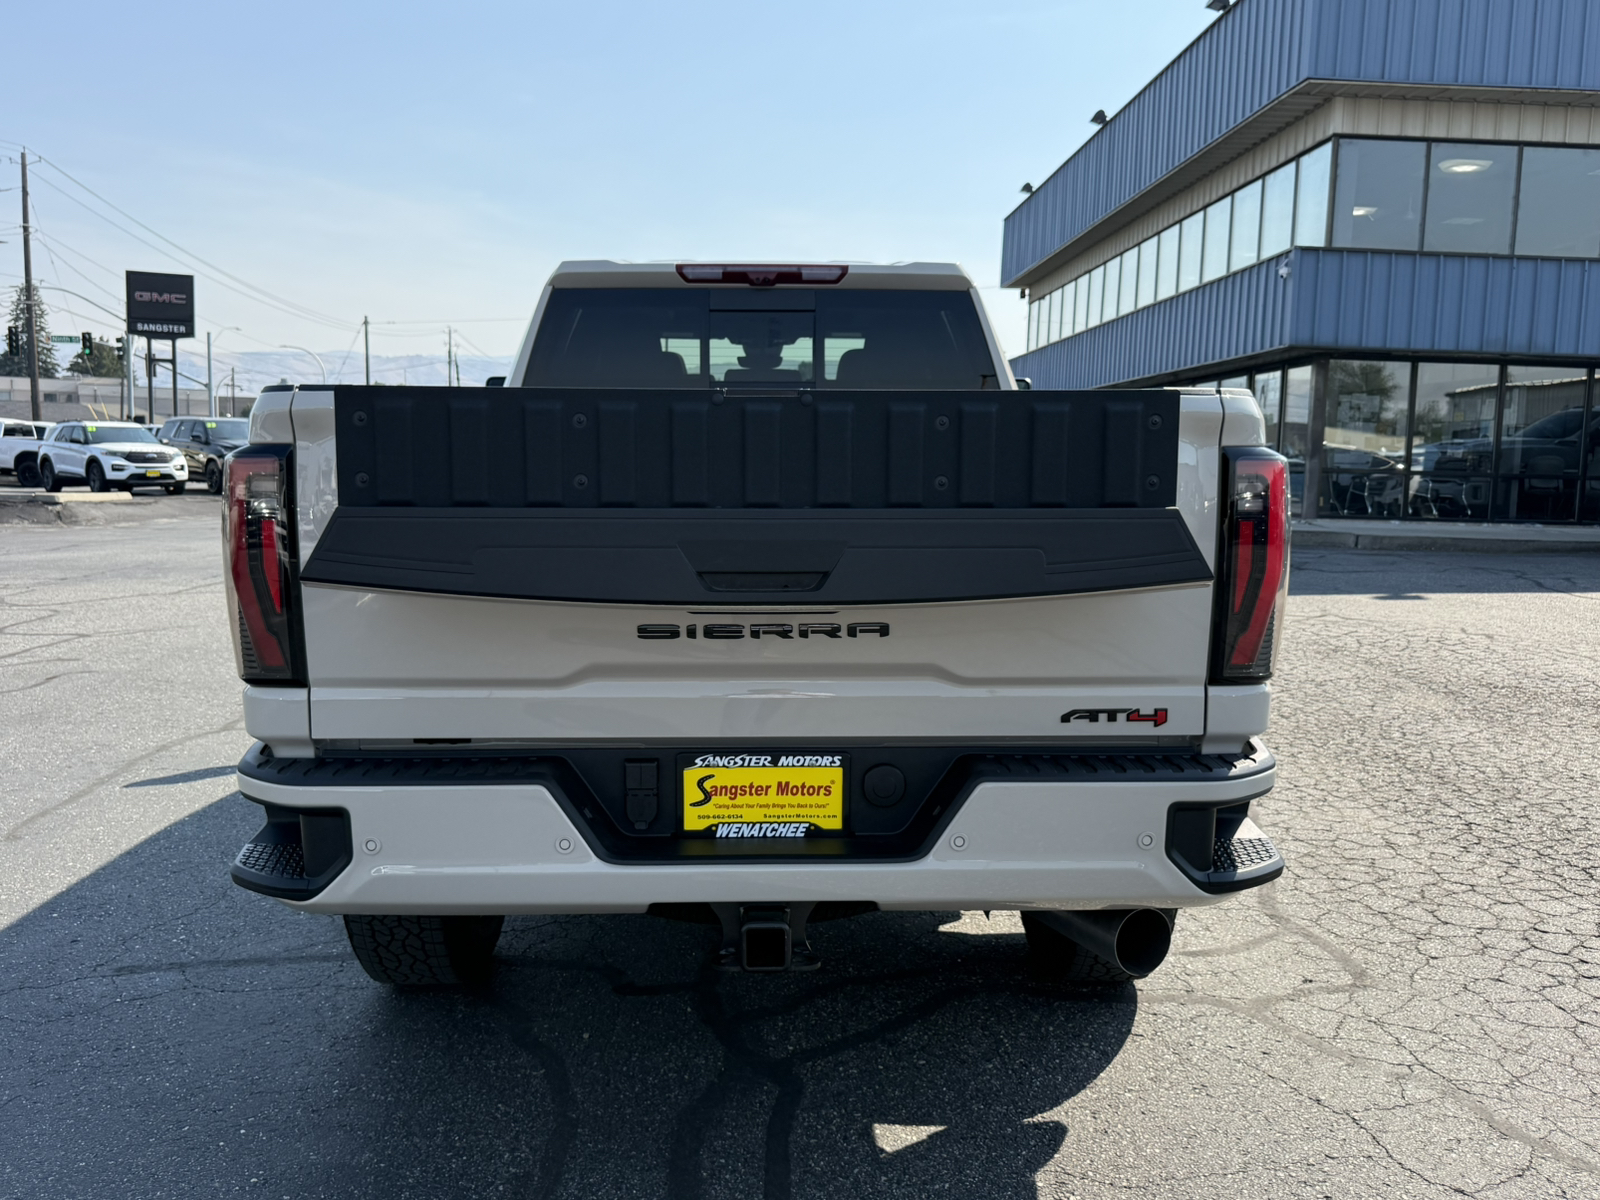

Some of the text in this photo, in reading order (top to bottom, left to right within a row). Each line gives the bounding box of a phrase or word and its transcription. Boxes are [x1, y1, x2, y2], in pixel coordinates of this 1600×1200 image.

[135, 291, 187, 304] GMC
[137, 322, 186, 333] SANGSTER
[637, 622, 890, 640] SIERRA
[1060, 708, 1168, 728] AT4
[684, 754, 842, 770] SANGSTER MOTORS
[689, 774, 772, 808] Sangster
[716, 823, 810, 838] WENATCHEE
